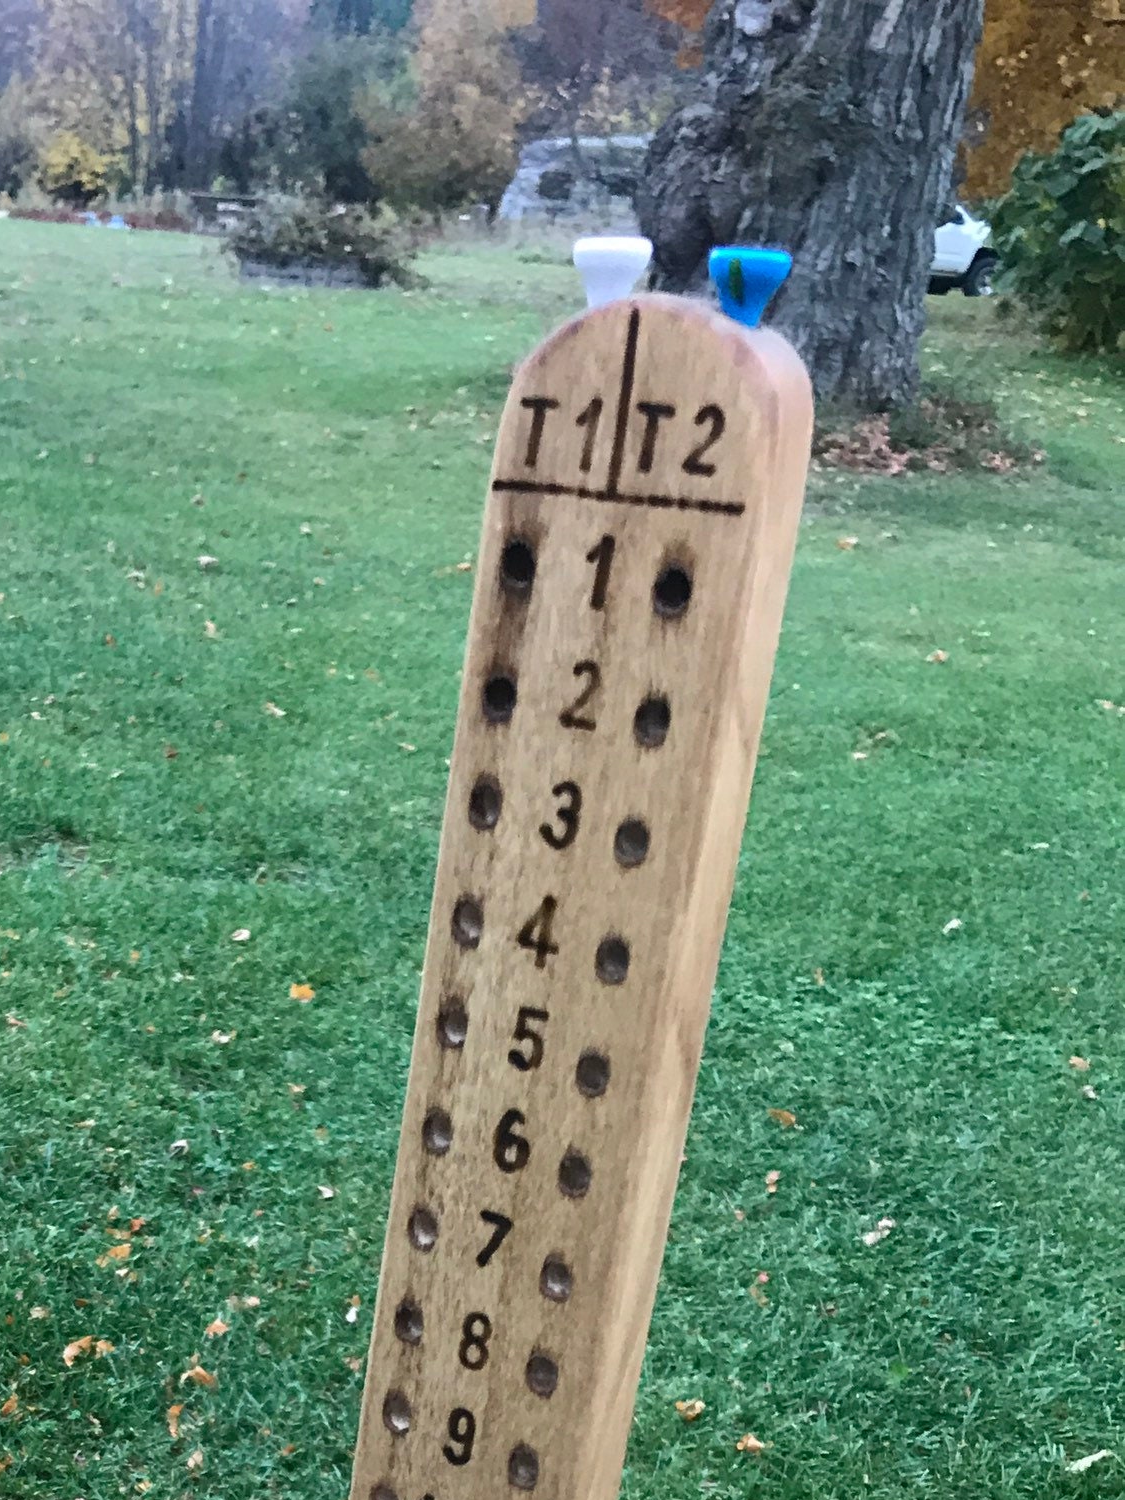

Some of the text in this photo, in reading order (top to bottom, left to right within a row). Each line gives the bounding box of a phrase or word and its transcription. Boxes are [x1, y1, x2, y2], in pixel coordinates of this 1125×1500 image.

[585, 533, 616, 611] 1
[559, 660, 602, 731] 2
[538, 780, 582, 850] 3
[516, 895, 559, 969] 4
[507, 1006, 549, 1072] 5
[493, 1108, 531, 1174] 6
[476, 1209, 514, 1268] 7
[459, 1311, 492, 1371] 8
[442, 1407, 476, 1466] 9
